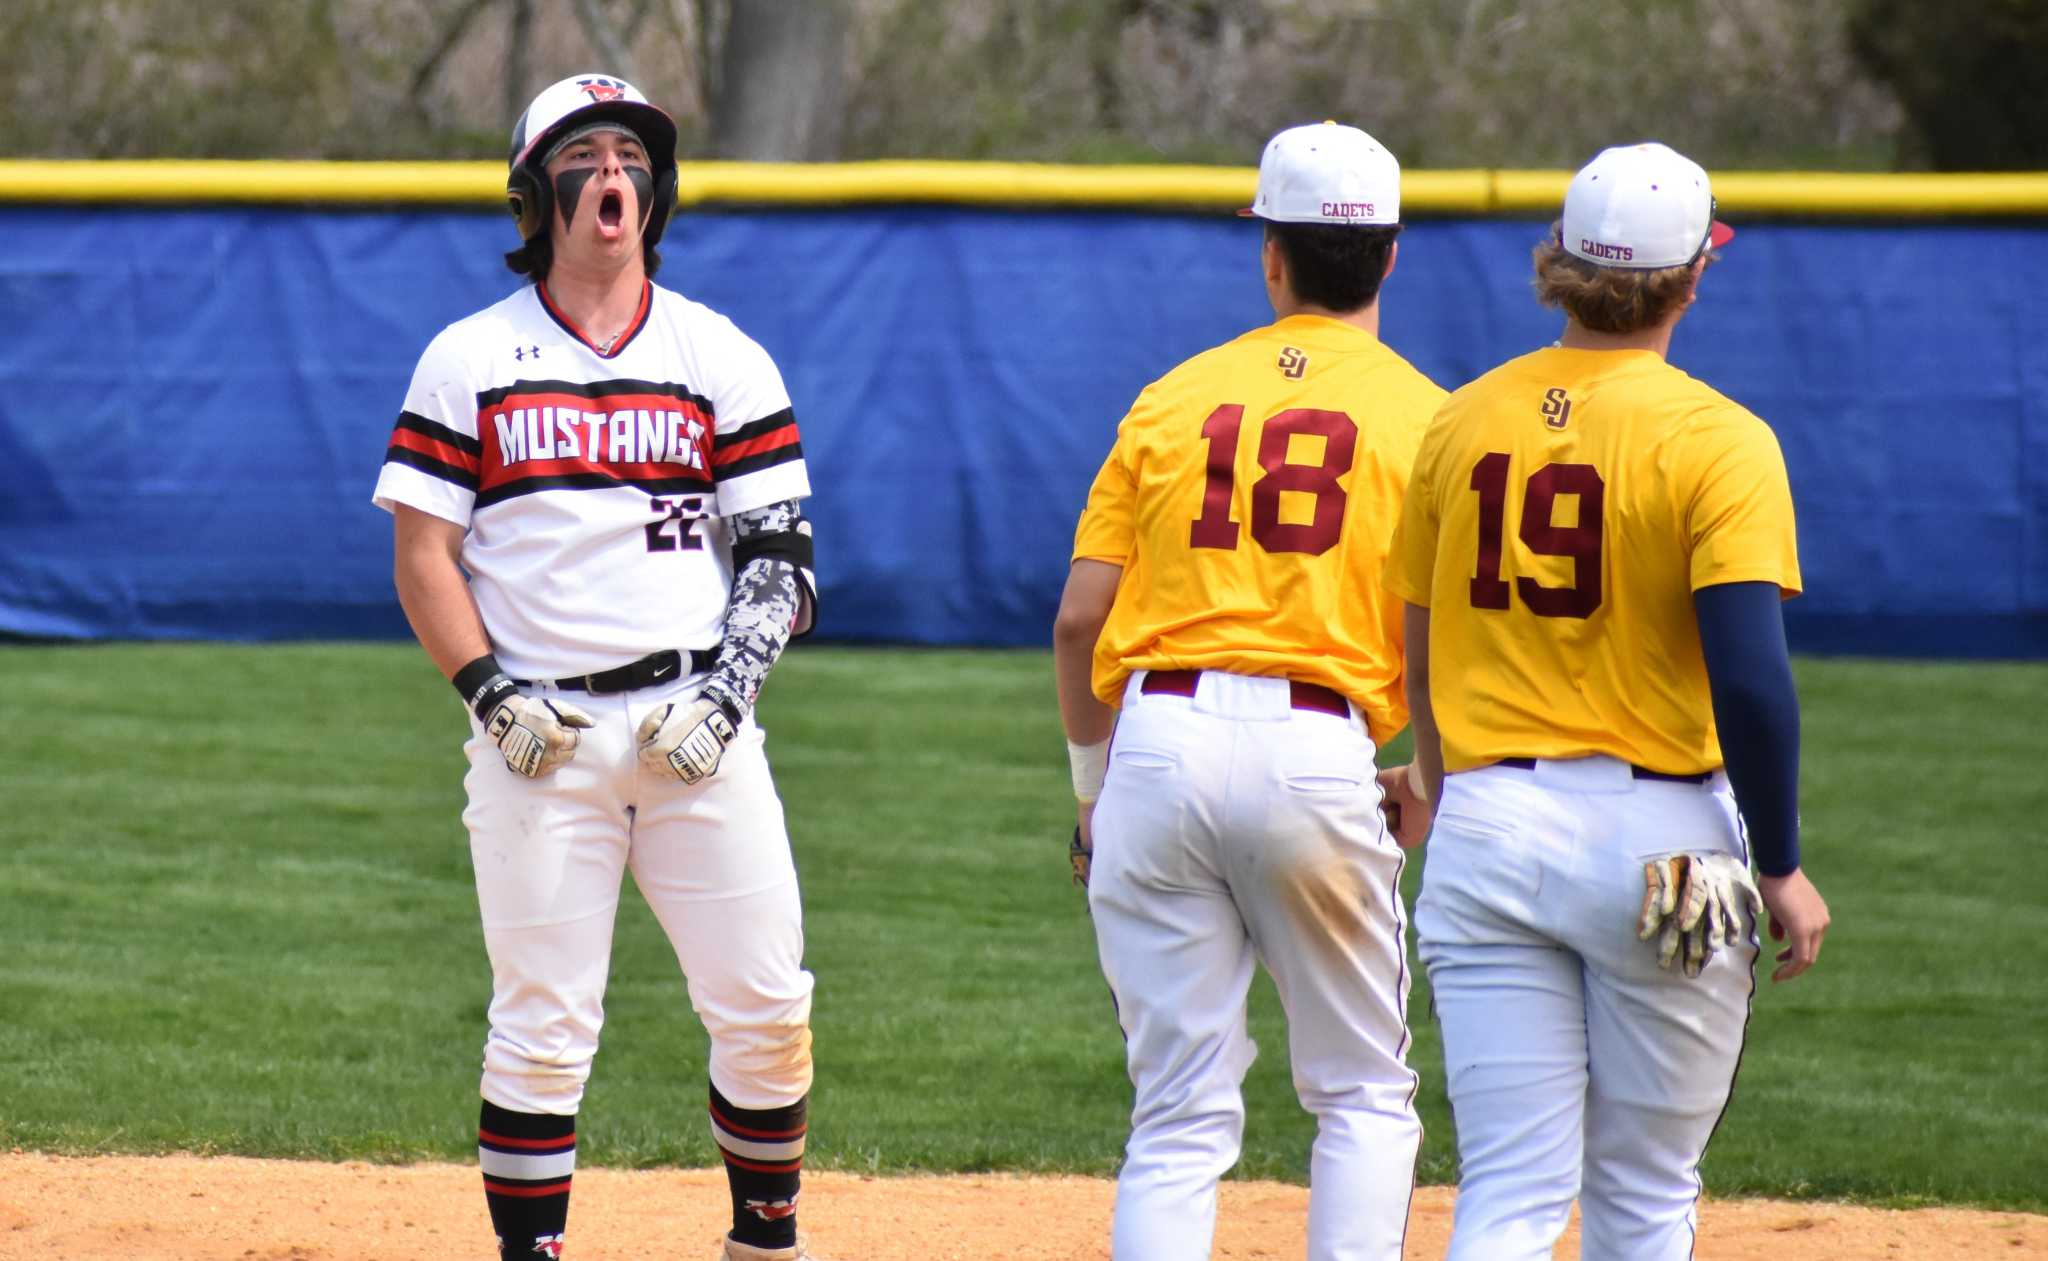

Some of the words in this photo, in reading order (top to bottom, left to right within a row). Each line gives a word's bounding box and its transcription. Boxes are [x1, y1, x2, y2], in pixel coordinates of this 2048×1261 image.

[1322, 202, 1375, 217] CADETS
[1581, 239, 1633, 261] CADETS
[1190, 403, 1358, 556] 18
[645, 497, 709, 553] 22
[1470, 452, 1605, 619] 19
